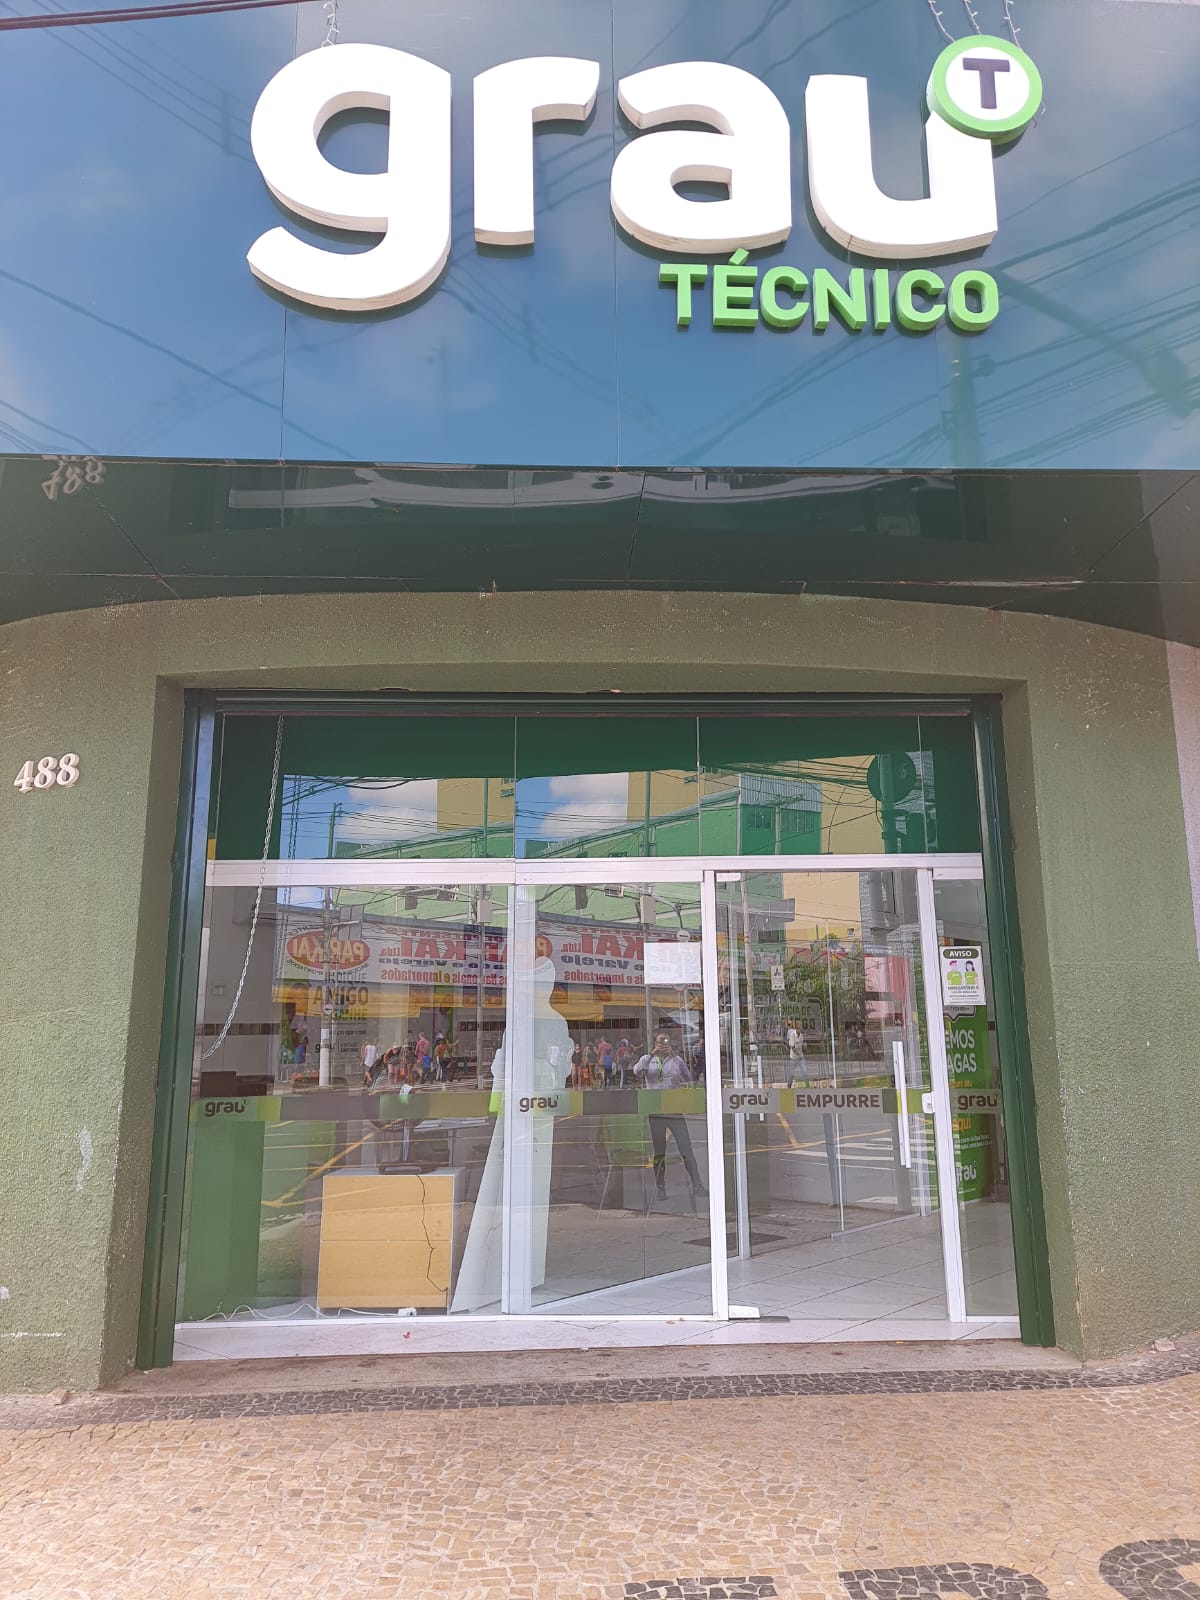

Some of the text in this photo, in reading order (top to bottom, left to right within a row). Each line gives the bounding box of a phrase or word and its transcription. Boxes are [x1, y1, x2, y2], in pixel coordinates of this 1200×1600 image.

[247, 43, 998, 312] grau
[658, 248, 999, 331] TÉCNICO
[13, 752, 80, 794] 488
[944, 1029, 975, 1049] EMOS
[947, 1053, 977, 1073] AGAS
[205, 1101, 245, 1117] grau
[519, 1097, 558, 1112] grau
[729, 1093, 769, 1109] grau
[796, 1094, 881, 1108] EMPURRE
[957, 1095, 998, 1110] grau
